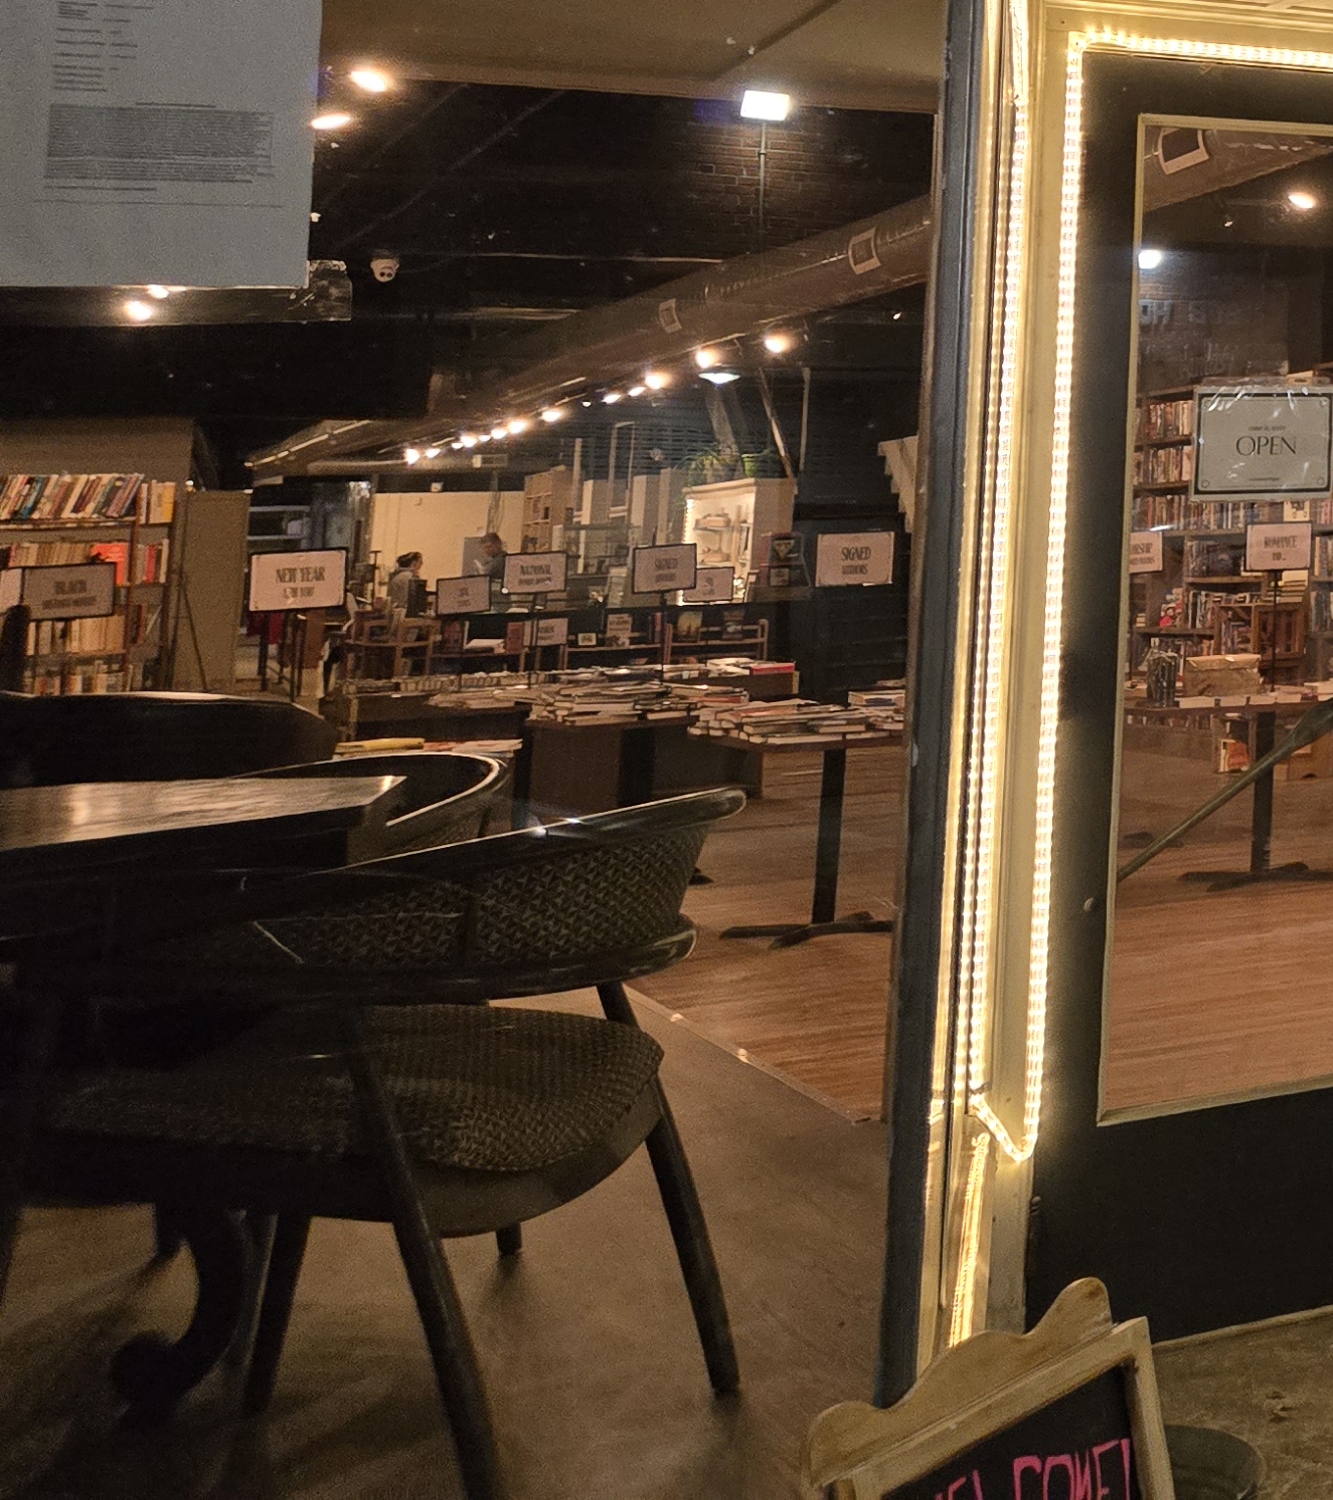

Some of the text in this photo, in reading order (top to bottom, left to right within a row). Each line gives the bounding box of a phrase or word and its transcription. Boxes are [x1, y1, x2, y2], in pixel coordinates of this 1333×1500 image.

[1236, 435, 1297, 456] OPEN
[841, 546, 872, 561] SIGNED
[300, 566, 326, 582] YEAR
